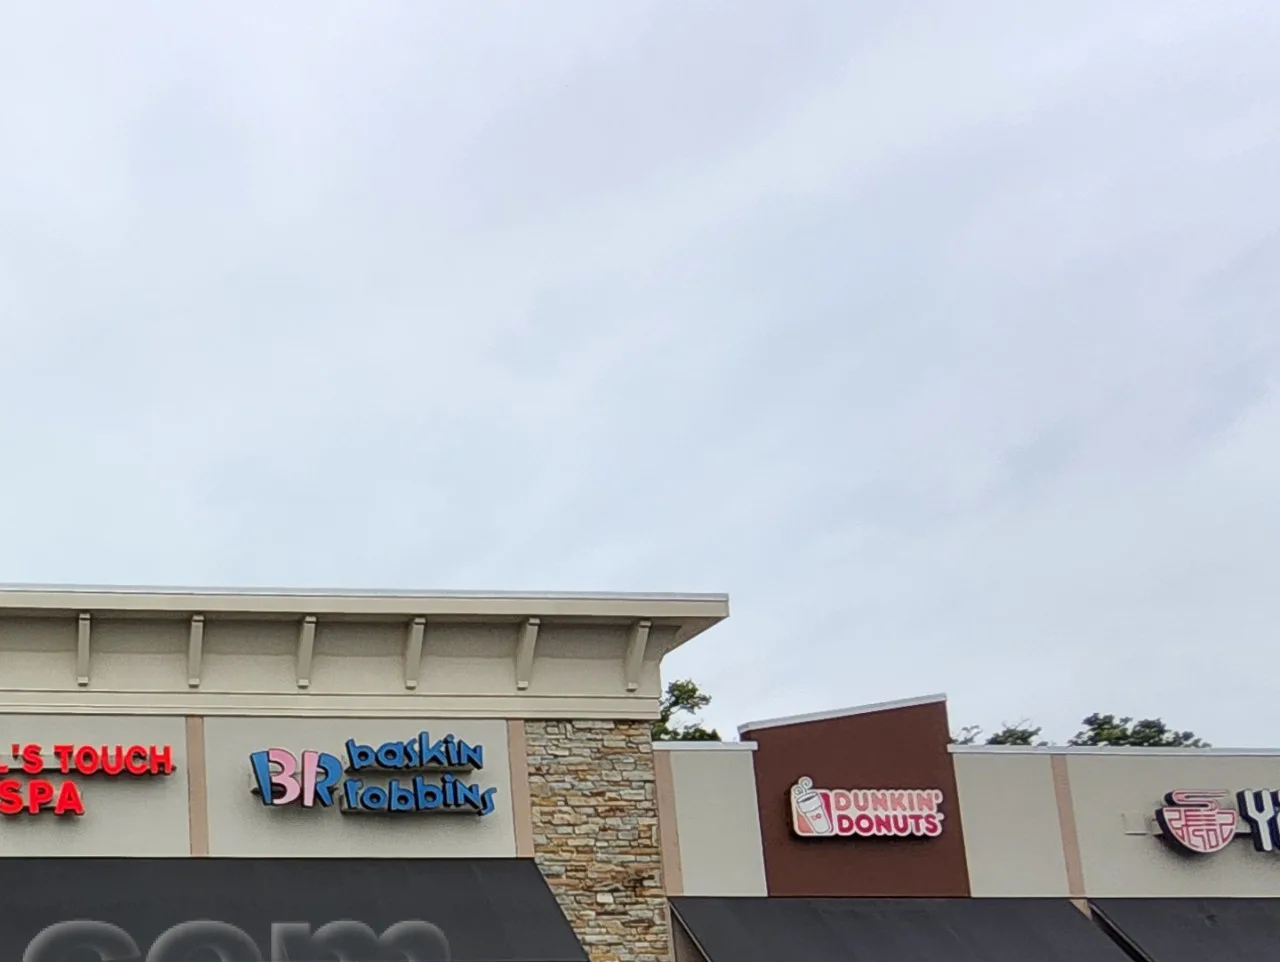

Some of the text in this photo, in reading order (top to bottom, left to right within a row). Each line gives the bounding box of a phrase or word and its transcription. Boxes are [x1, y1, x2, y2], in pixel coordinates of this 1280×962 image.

[53, 745, 174, 774] TOUCH
[345, 731, 483, 769] baskin
[250, 748, 343, 807] BR
[343, 773, 497, 816] robbins
[833, 791, 941, 812] DUNKIN'
[836, 813, 939, 834] DONUTS
